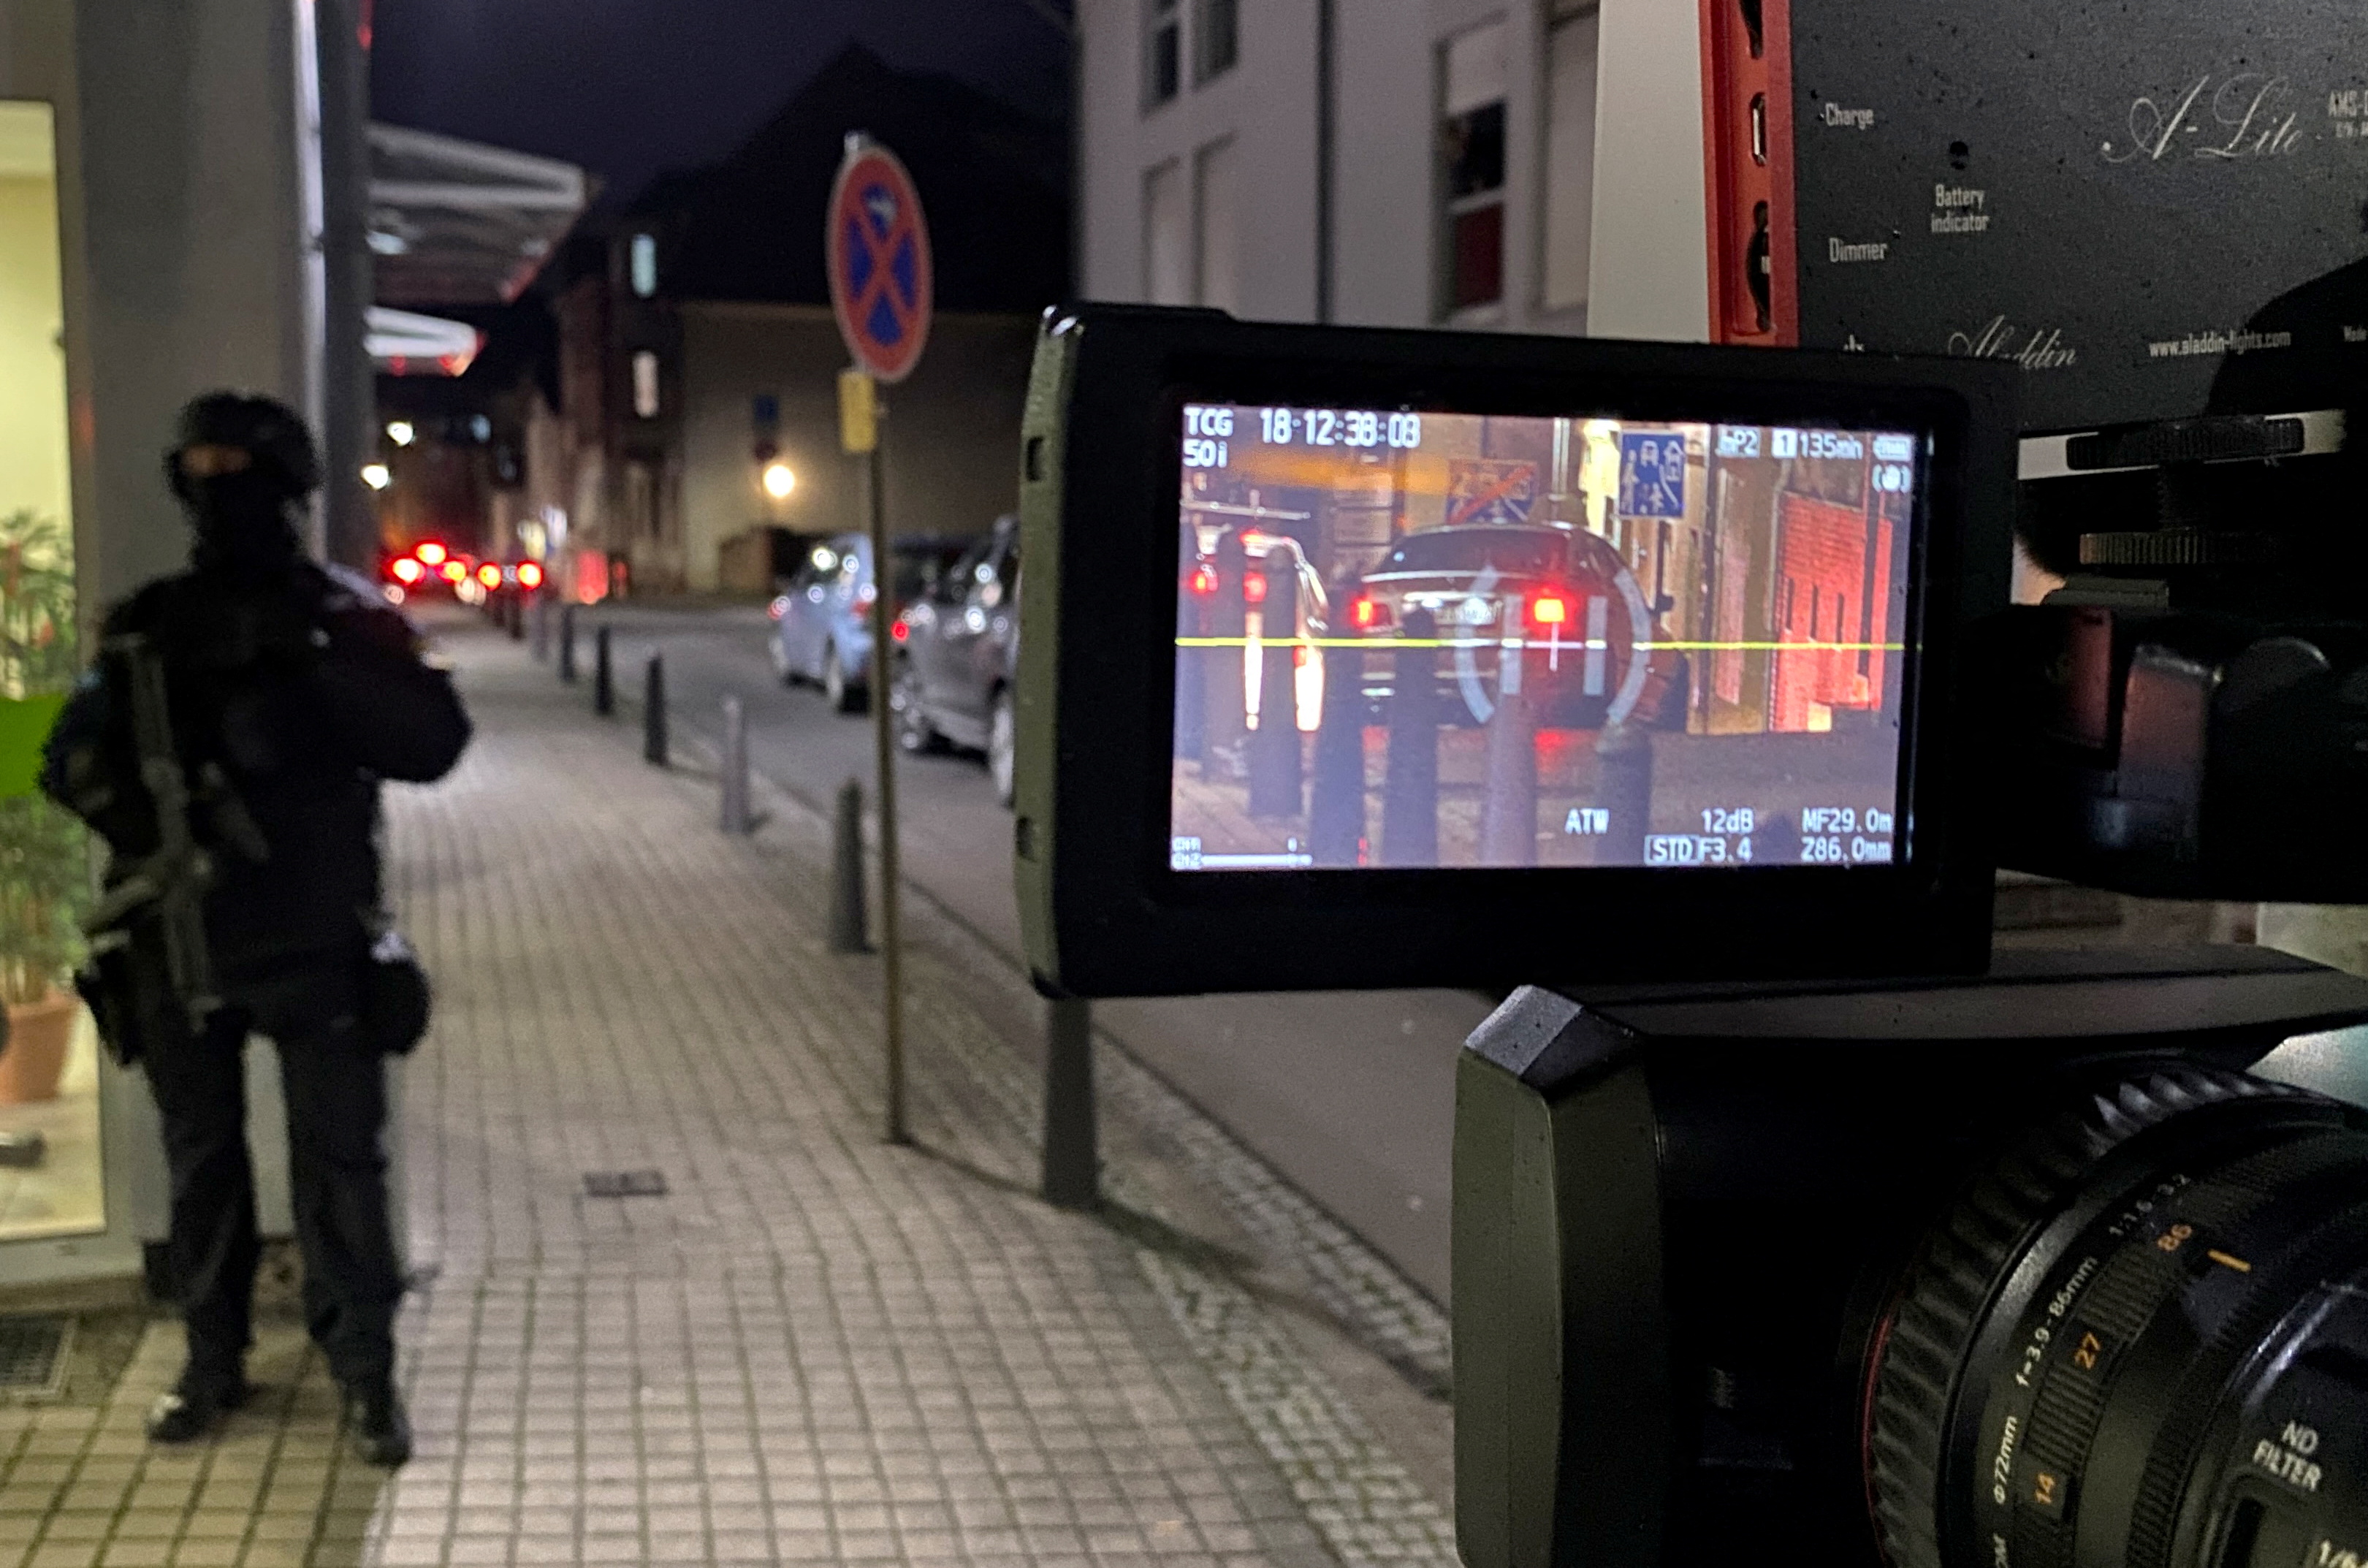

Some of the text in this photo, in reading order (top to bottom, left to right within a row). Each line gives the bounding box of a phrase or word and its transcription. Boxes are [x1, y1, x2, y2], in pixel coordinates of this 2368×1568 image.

[1826, 102, 1875, 130] Charge
[1935, 183, 1985, 210] Battery
[1931, 210, 1991, 233] indicator
[1830, 237, 1887, 262] Dimmer
[2148, 329, 2291, 357] www.aladdin-lights.com
[1184, 407, 1234, 437] TCG
[1183, 439, 1228, 468] 50i
[1564, 807, 1609, 834] ATW
[1702, 807, 1754, 833] 12dB
[1650, 836, 1695, 864] STD
[1699, 836, 1753, 863] F3.4
[2156, 1223, 2193, 1252] 86
[2074, 1331, 2101, 1370] 27
[2281, 1419, 2319, 1455] ND
[2253, 1438, 2323, 1492] FILTER
[2033, 1472, 2056, 1505] 14
